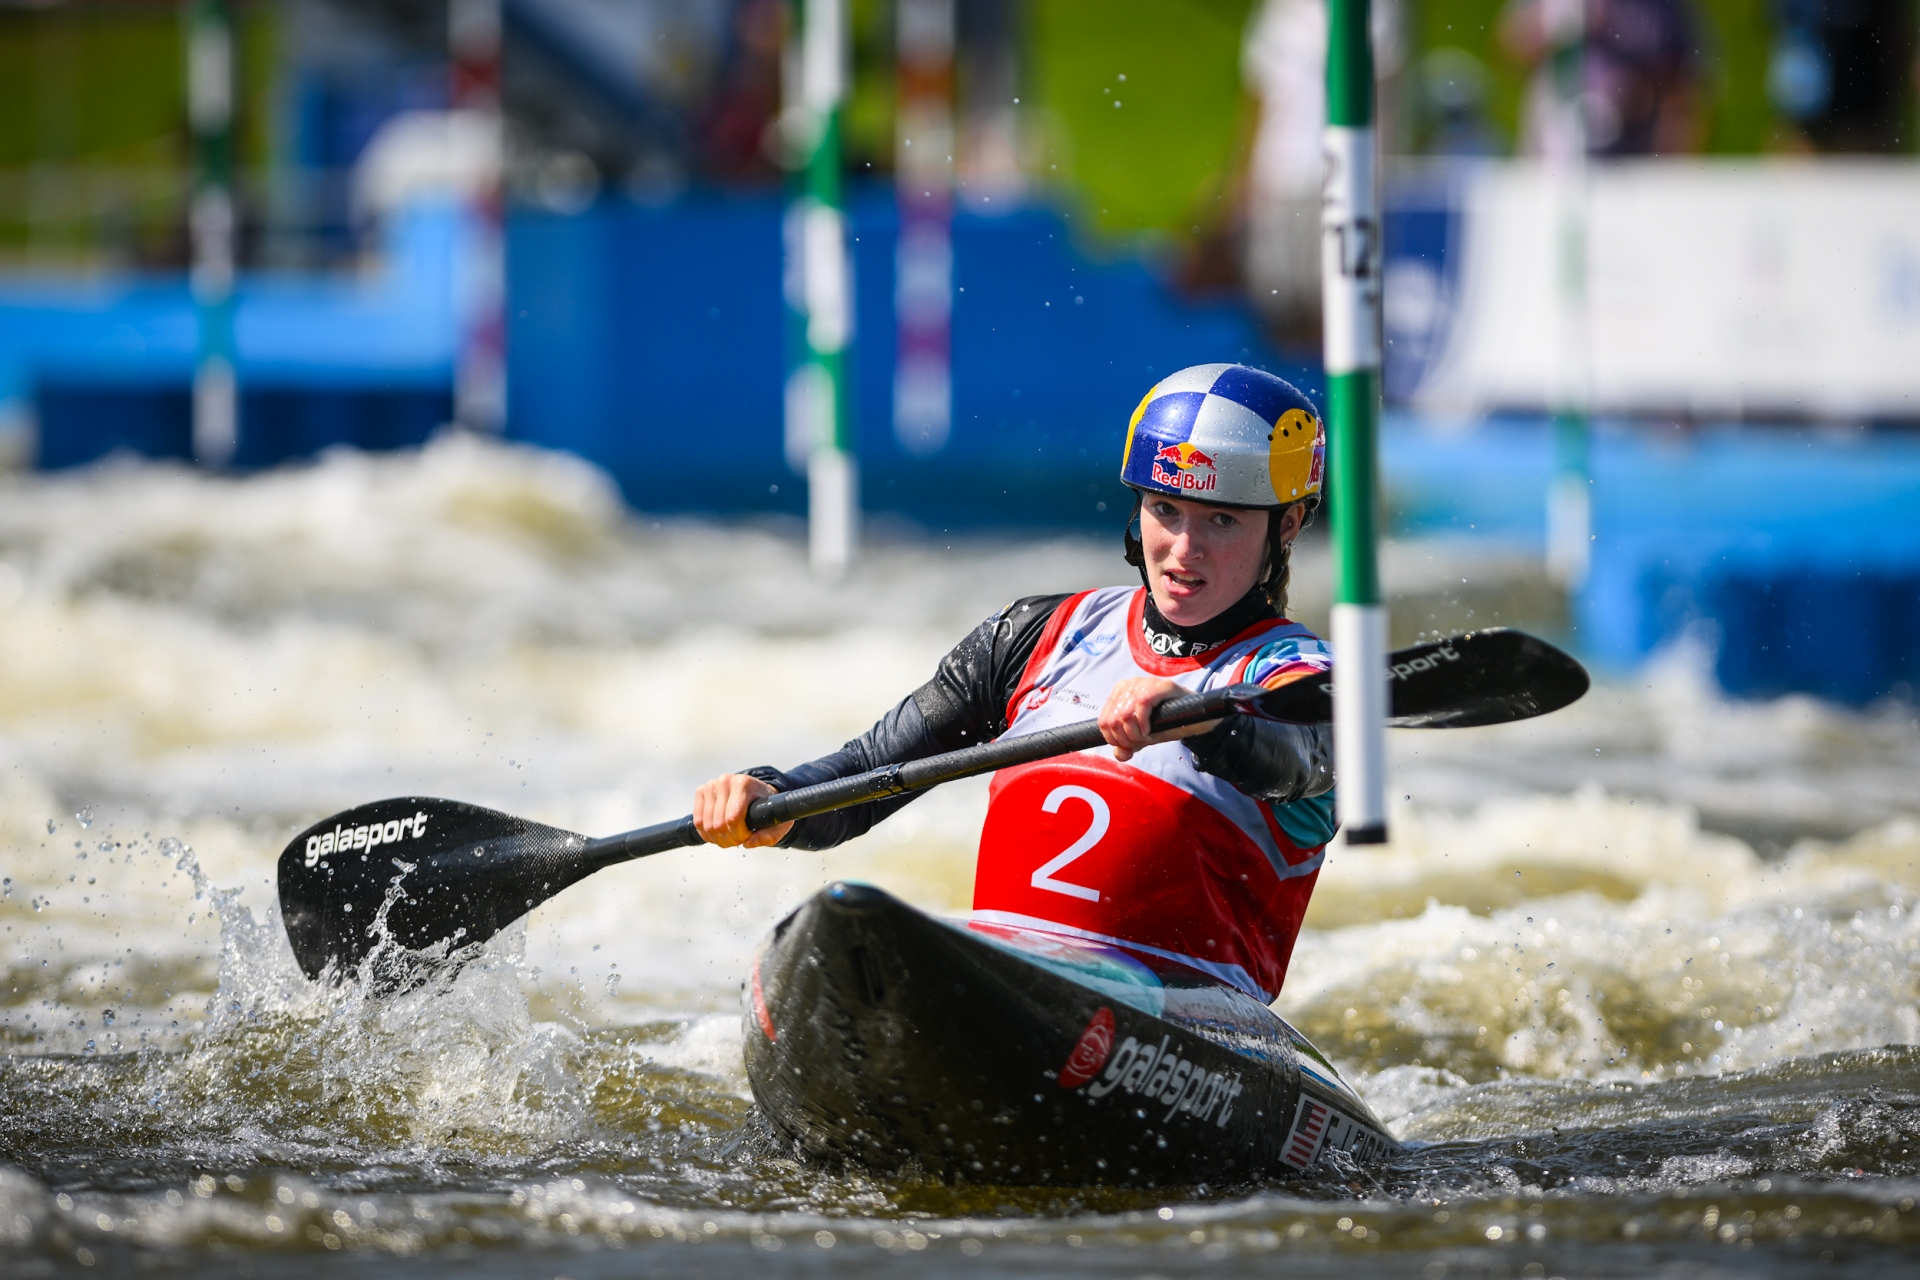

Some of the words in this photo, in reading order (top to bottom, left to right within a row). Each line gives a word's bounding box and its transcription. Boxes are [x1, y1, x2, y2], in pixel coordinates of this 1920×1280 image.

[1152, 462, 1182, 488] Red
[1183, 470, 1217, 490] Bull
[305, 811, 427, 867] galasport
[1031, 784, 1110, 903] 2
[1086, 1034, 1243, 1128] galasport
